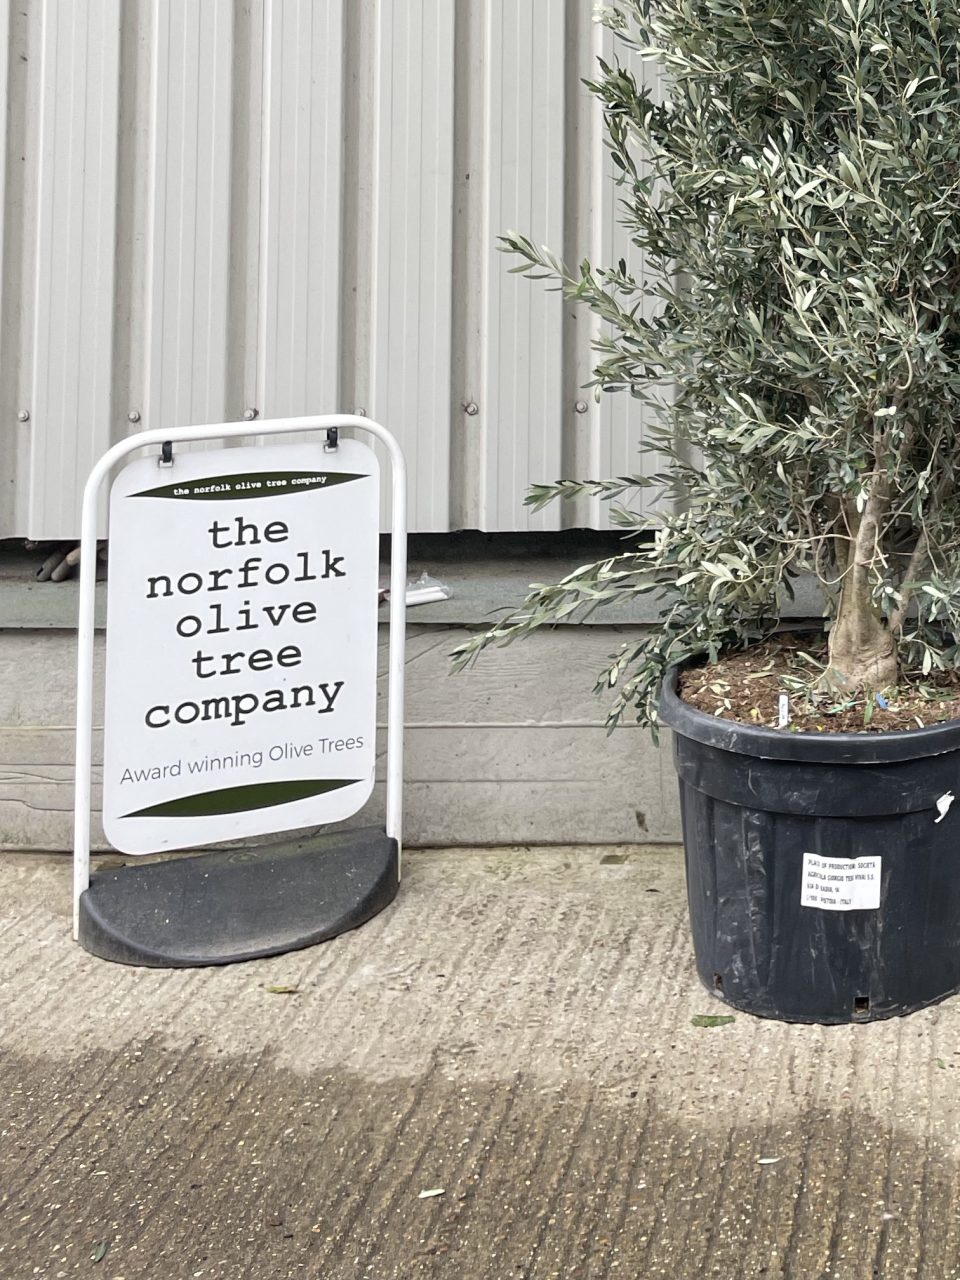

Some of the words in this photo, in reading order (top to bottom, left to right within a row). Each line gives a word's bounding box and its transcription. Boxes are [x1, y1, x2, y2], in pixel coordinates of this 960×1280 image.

[173, 487, 190, 496] the
[194, 483, 231, 494] norfolk
[235, 481, 262, 490] olive
[266, 479, 287, 487] tree
[291, 475, 327, 485] company
[208, 516, 289, 549] the
[146, 549, 347, 599] norfolk
[176, 601, 317, 638] olive
[191, 645, 302, 679] tree
[145, 681, 345, 729] company
[119, 759, 182, 785] Award
[187, 751, 263, 774] winning
[268, 741, 314, 762] Olive
[319, 736, 364, 754] Trees
